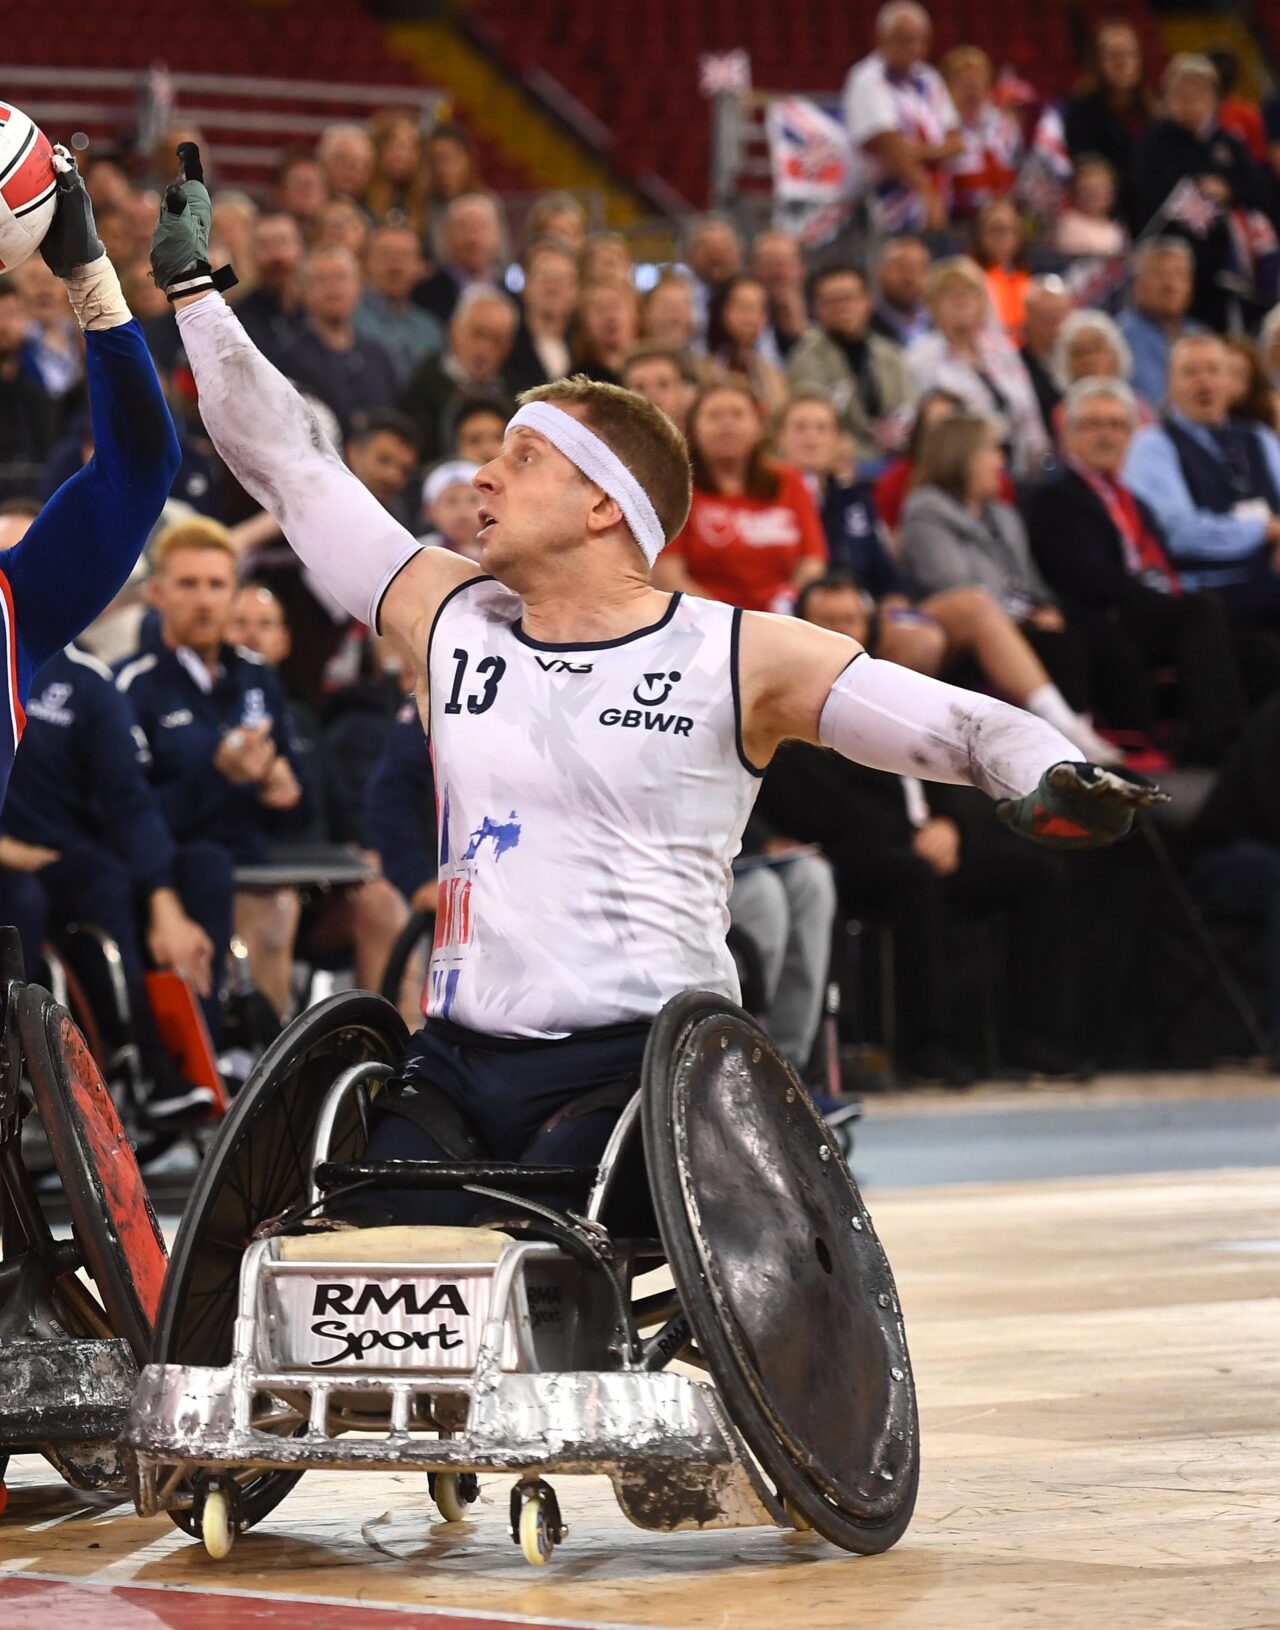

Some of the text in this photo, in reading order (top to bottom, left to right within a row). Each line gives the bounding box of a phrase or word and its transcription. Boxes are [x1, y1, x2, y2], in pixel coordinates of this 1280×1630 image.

[444, 648, 507, 715] 13
[599, 708, 694, 737] GBWR
[312, 1283, 470, 1317] RMA
[311, 1319, 464, 1367] Sport
